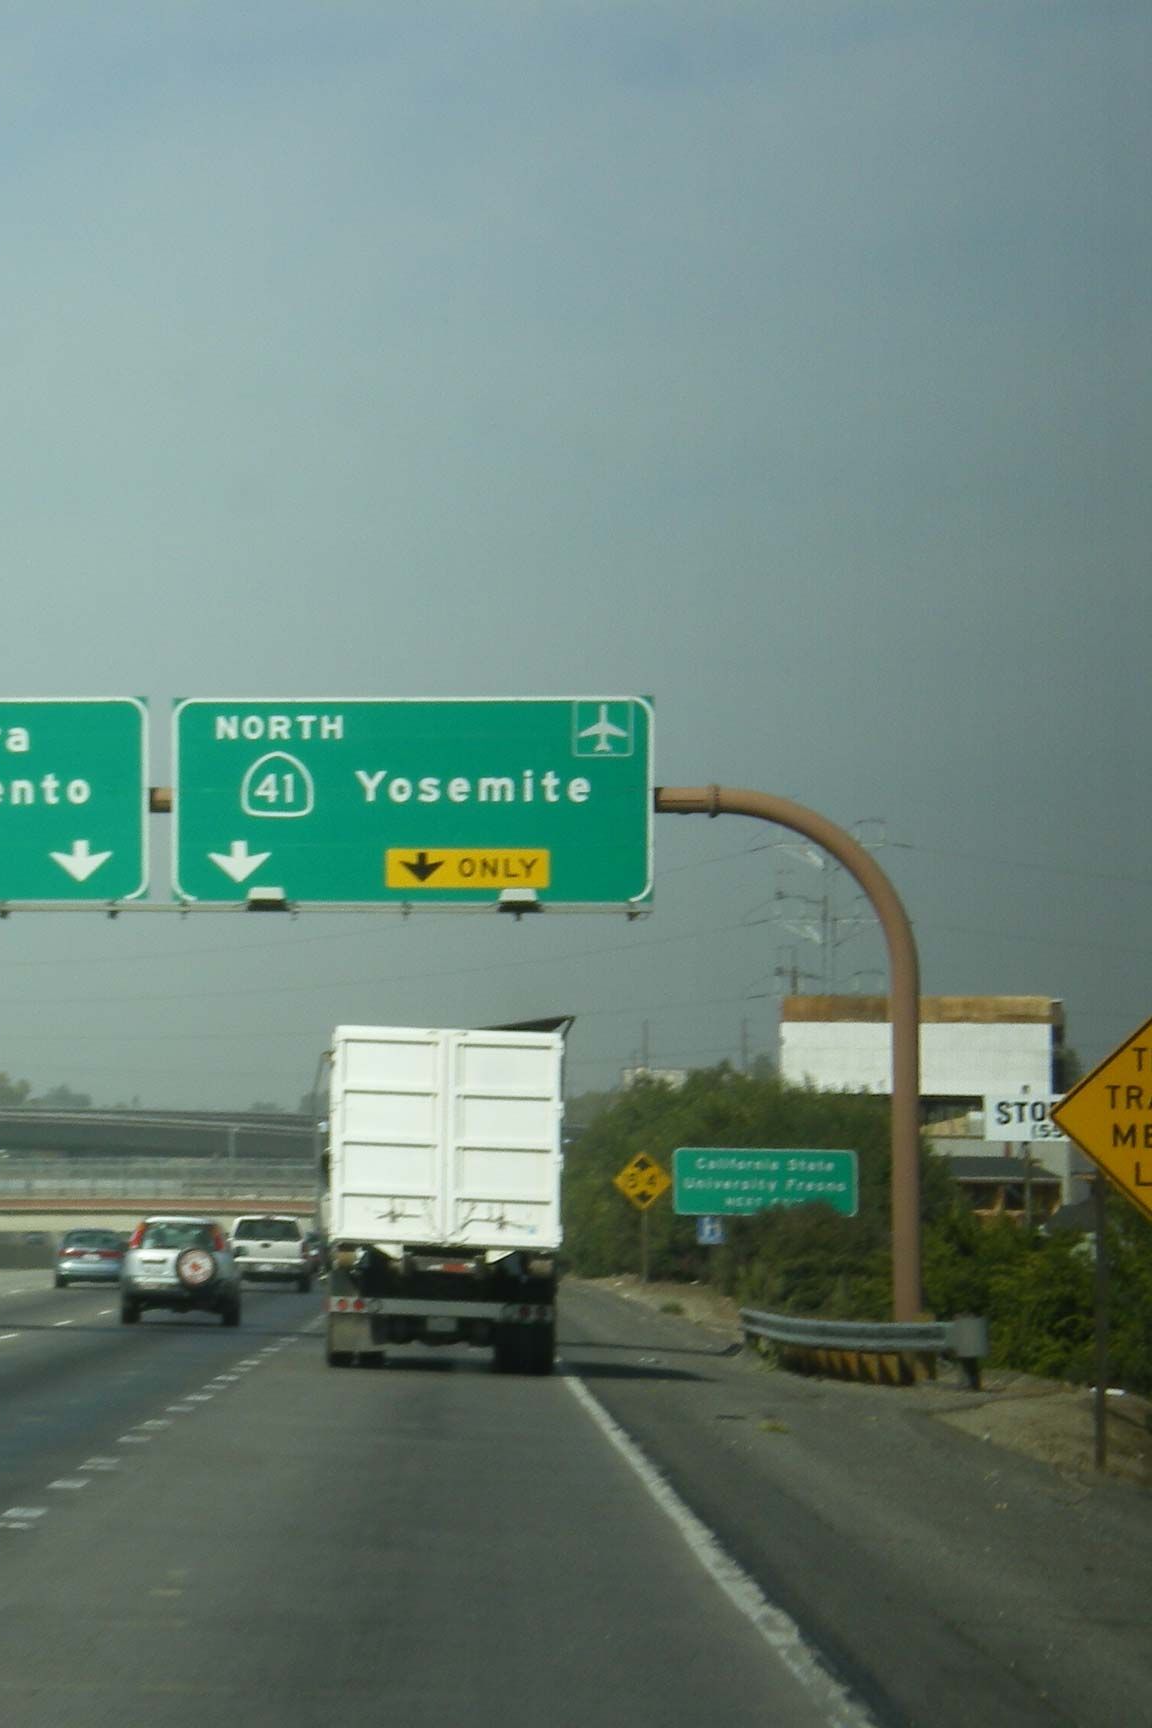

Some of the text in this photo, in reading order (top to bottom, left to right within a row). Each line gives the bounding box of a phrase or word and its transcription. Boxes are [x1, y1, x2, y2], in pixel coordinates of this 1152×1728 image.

[215, 715, 344, 740] NORTH
[254, 773, 294, 803] 41
[355, 769, 592, 803] Yosemite
[458, 857, 538, 879] ONLY
[1132, 1047, 1152, 1072] T
[1105, 1085, 1152, 1110] TR
[996, 1101, 1059, 1125] STO
[695, 1157, 835, 1172] California State
[682, 1177, 847, 1192] University Fresno
